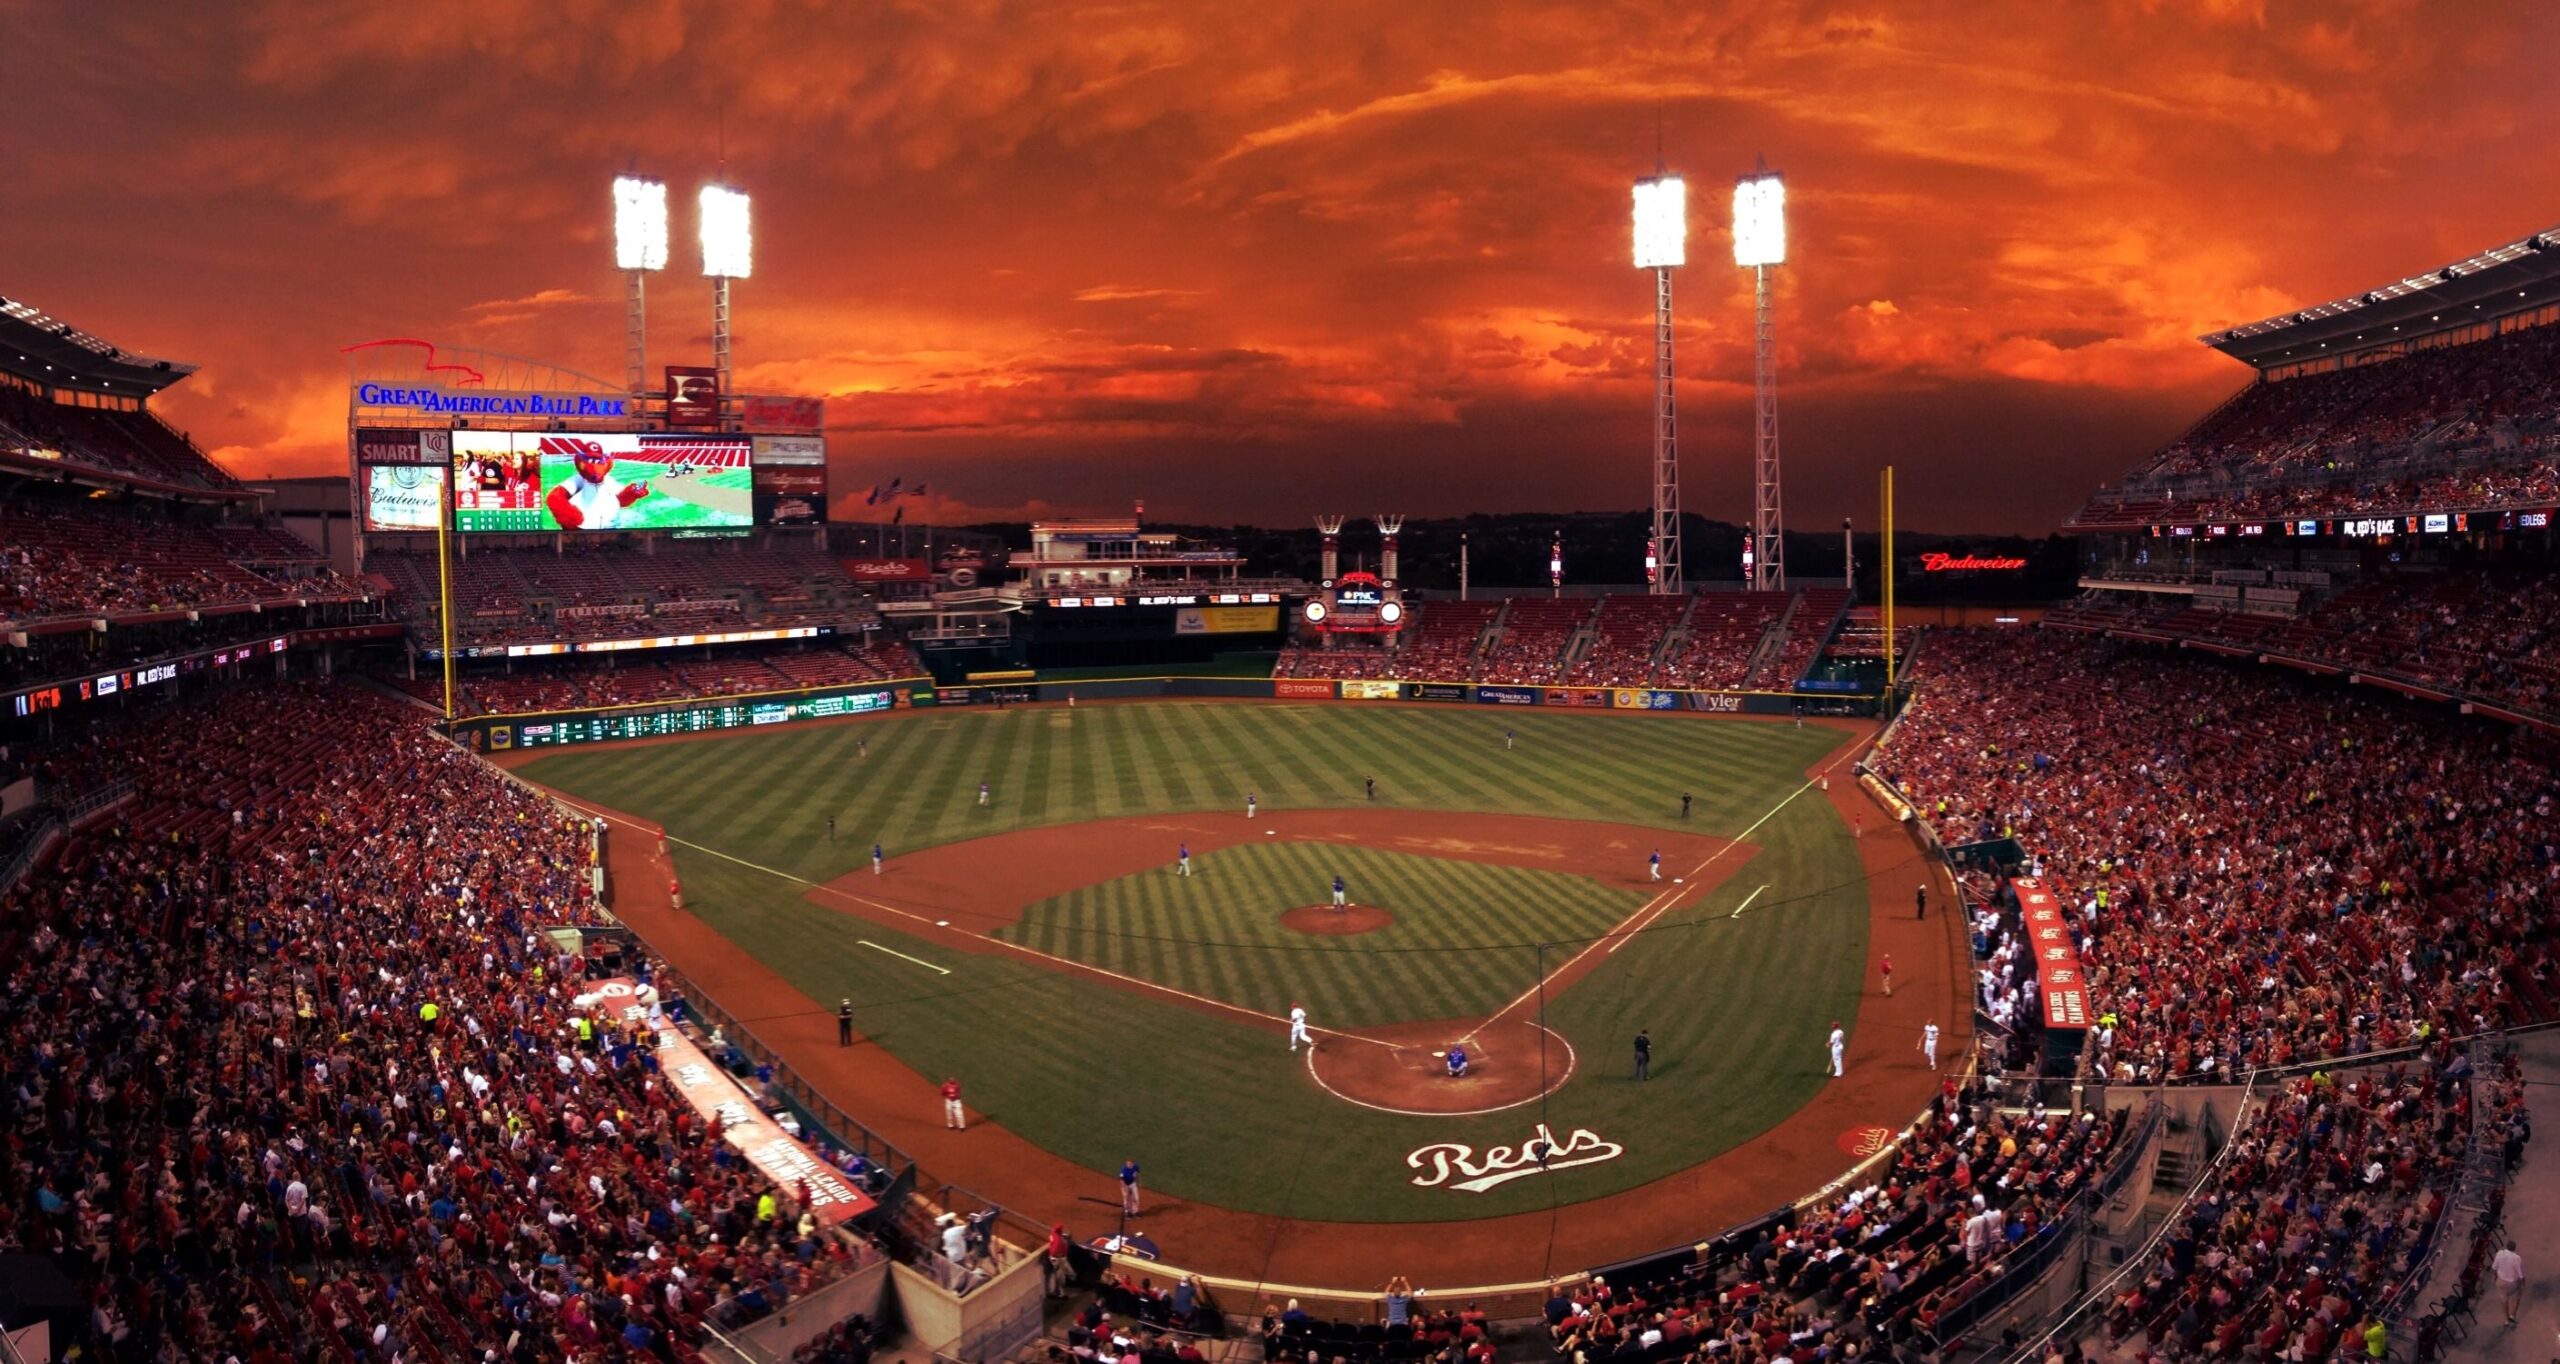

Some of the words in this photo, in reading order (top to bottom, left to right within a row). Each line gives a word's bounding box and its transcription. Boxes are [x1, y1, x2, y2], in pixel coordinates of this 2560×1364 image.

[360, 384, 432, 406] GREAT
[424, 393, 528, 414] AMERICAN
[530, 394, 577, 415] BALL
[578, 396, 626, 416] PARK
[362, 444, 417, 461] SMART
[370, 486, 439, 507] Budweise
[854, 561, 911, 575] Reds
[1920, 552, 2027, 571] Budweiser
[1353, 591, 1375, 600] PNC
[1293, 685, 1330, 694] TOYOTA
[798, 704, 815, 714] PNC
[2064, 990, 2085, 1024] CHAMPIONS
[1852, 1128, 1889, 1157] Reds
[1407, 1123, 1623, 1193] Reds
[811, 1171, 858, 1204] LEAGUE
